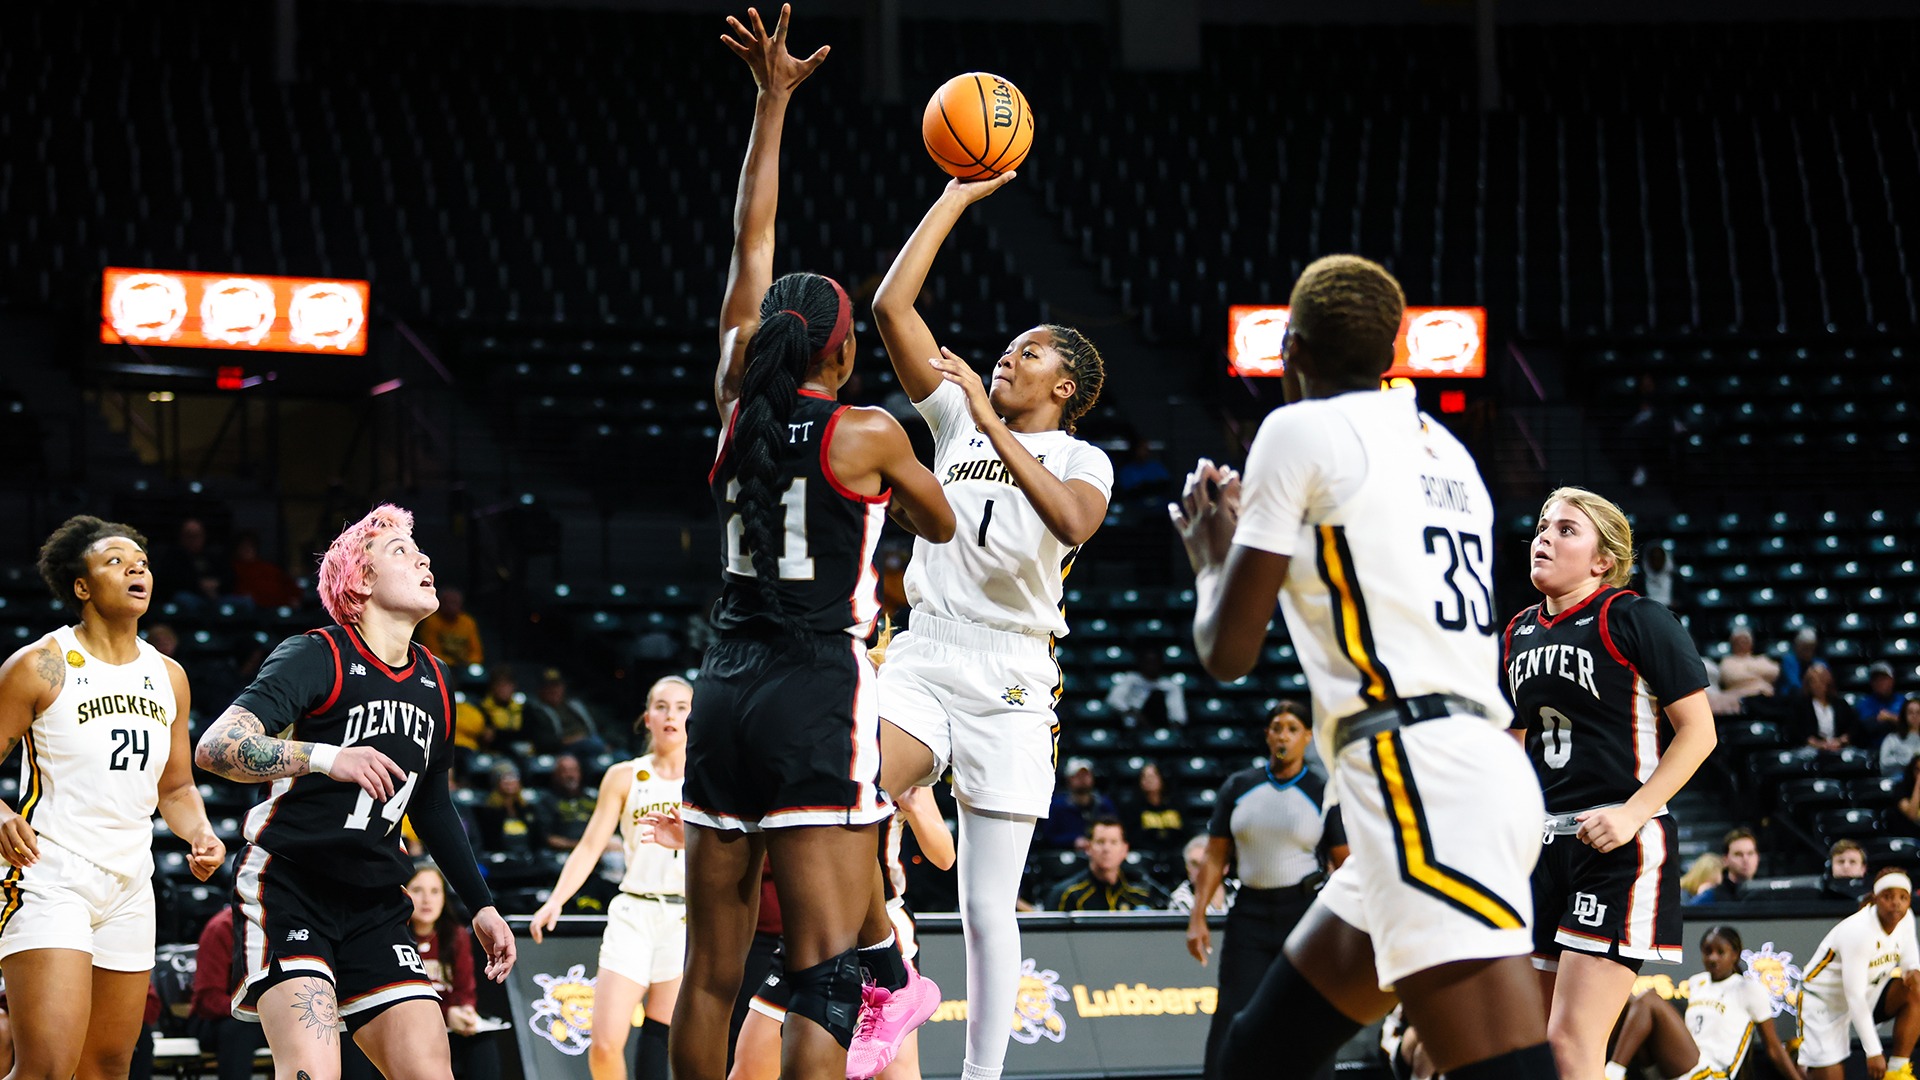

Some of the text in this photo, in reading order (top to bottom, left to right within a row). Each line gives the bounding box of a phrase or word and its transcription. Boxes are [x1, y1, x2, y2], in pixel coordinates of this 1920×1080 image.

[943, 460, 1018, 487] SHOCK
[978, 499, 994, 547] 1
[1424, 526, 1496, 637] 35
[1508, 644, 1600, 707] DENVER
[77, 694, 168, 727] SHOCKERS
[341, 700, 435, 771] DENVER
[1538, 706, 1572, 769] 0
[109, 729, 150, 771] 24
[344, 771, 418, 837] 14
[1072, 984, 1218, 1018] Lubbers
